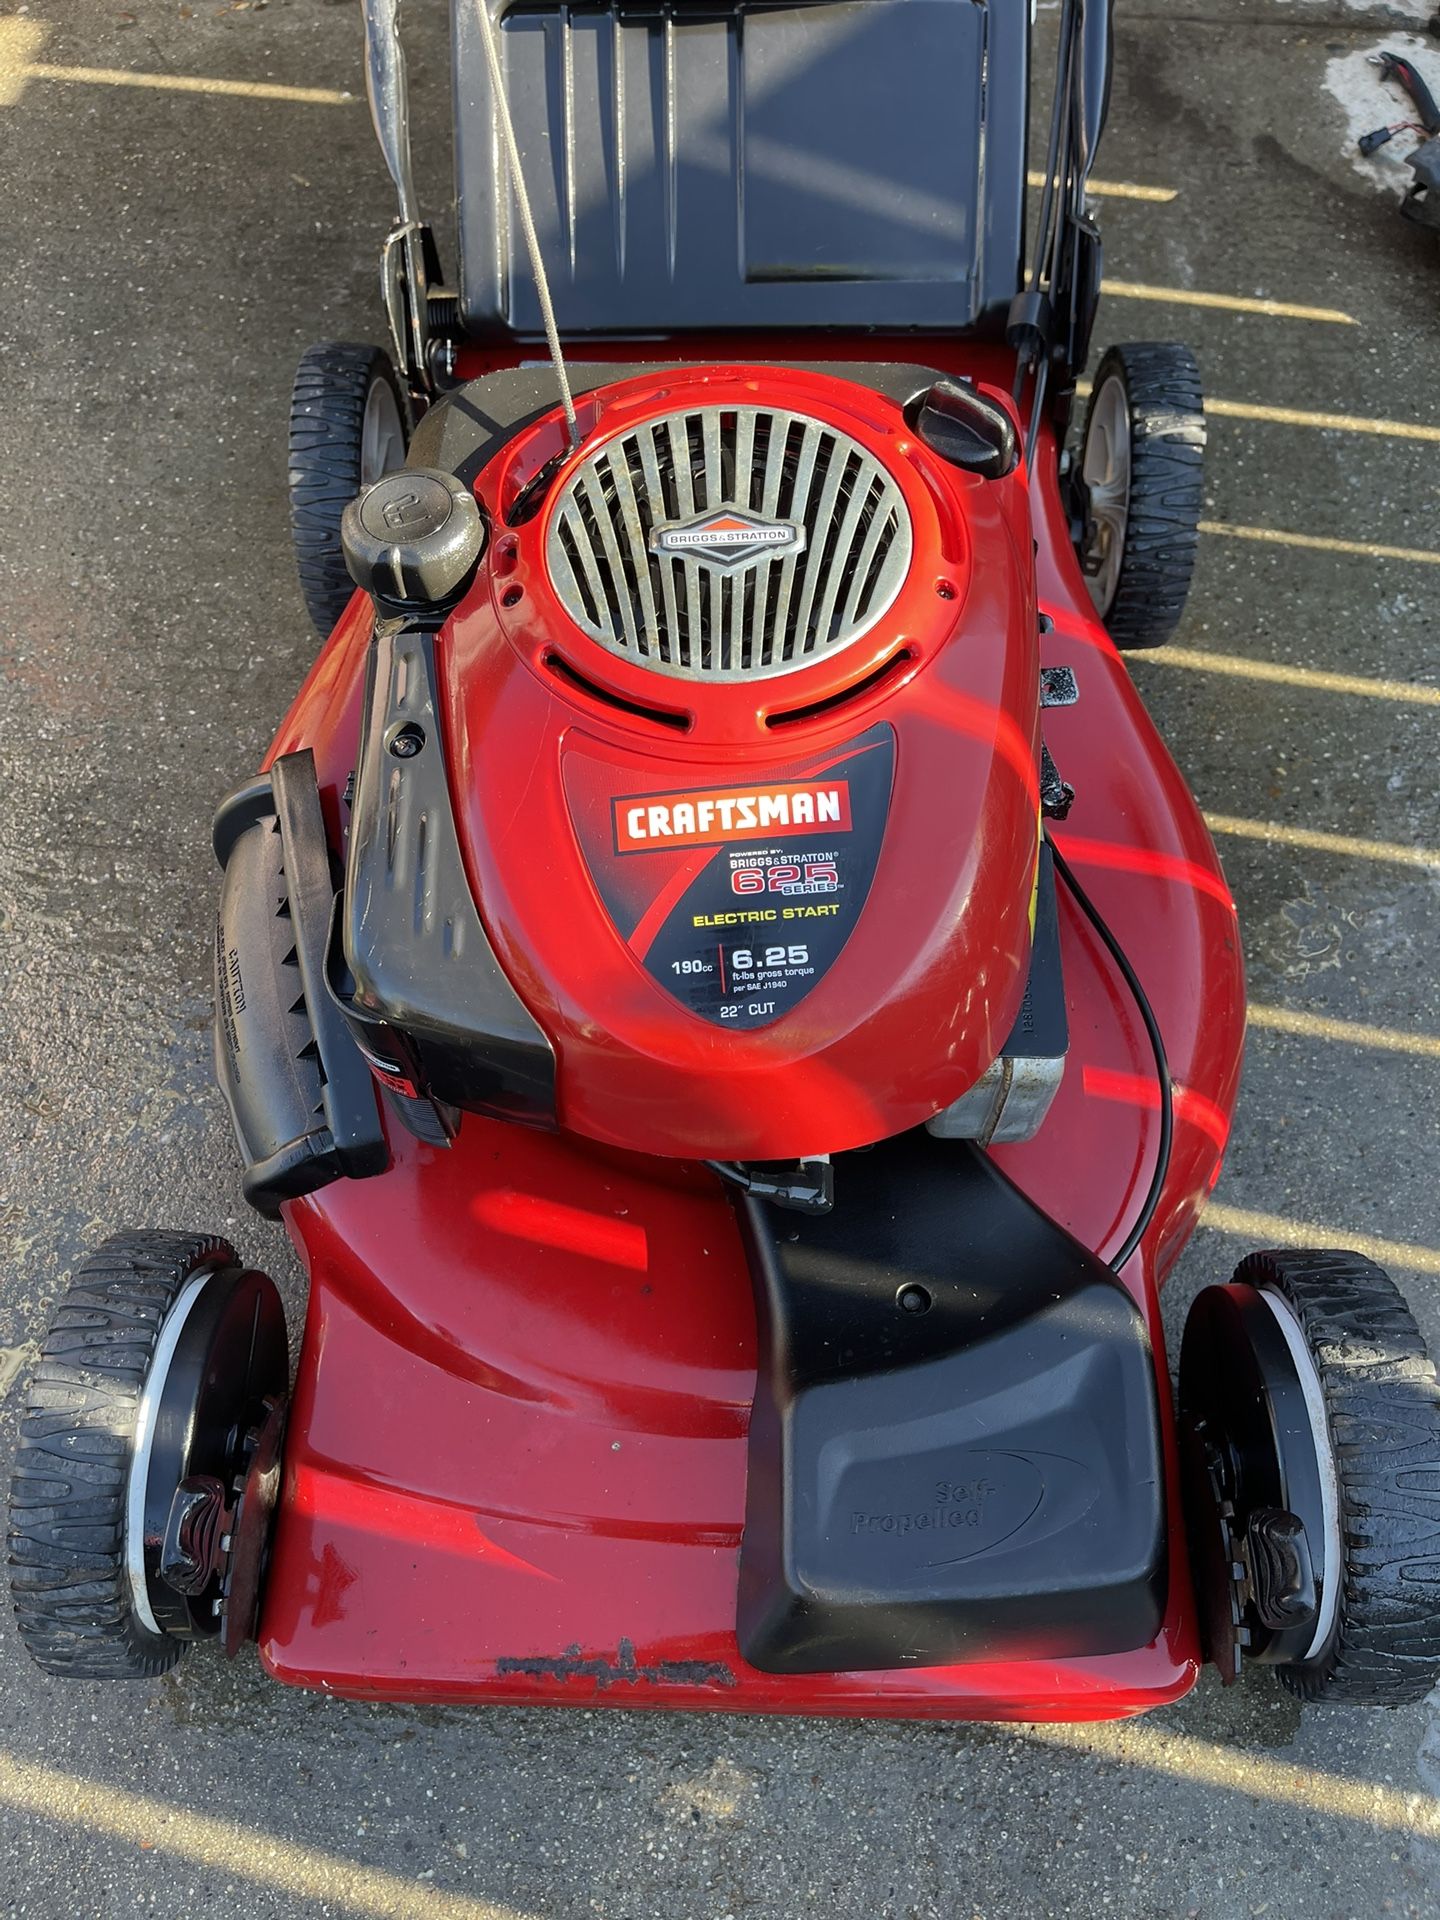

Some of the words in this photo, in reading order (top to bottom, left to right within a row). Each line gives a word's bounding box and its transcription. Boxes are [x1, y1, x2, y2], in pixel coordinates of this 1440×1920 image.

[627, 791, 840, 839] CRAFTSMAN
[729, 850, 769, 858] POWERED
[731, 862, 838, 895] 625
[693, 909, 777, 927] ELECTRIC
[783, 904, 840, 919] START
[671, 960, 713, 975] 190cc
[732, 944, 809, 969] 6.25
[228, 948, 247, 1015] CAUTION
[732, 971, 755, 981] ft-lbs
[757, 970, 783, 981] gross
[784, 967, 815, 977] torque
[733, 985, 746, 993] per
[747, 983, 762, 991] SAE
[763, 980, 787, 990] J1940
[748, 1002, 776, 1016] CUT
[230, 1018, 241, 1053] WITHOUT
[935, 1478, 996, 1503] Self-
[851, 1504, 983, 1537] Propelled
